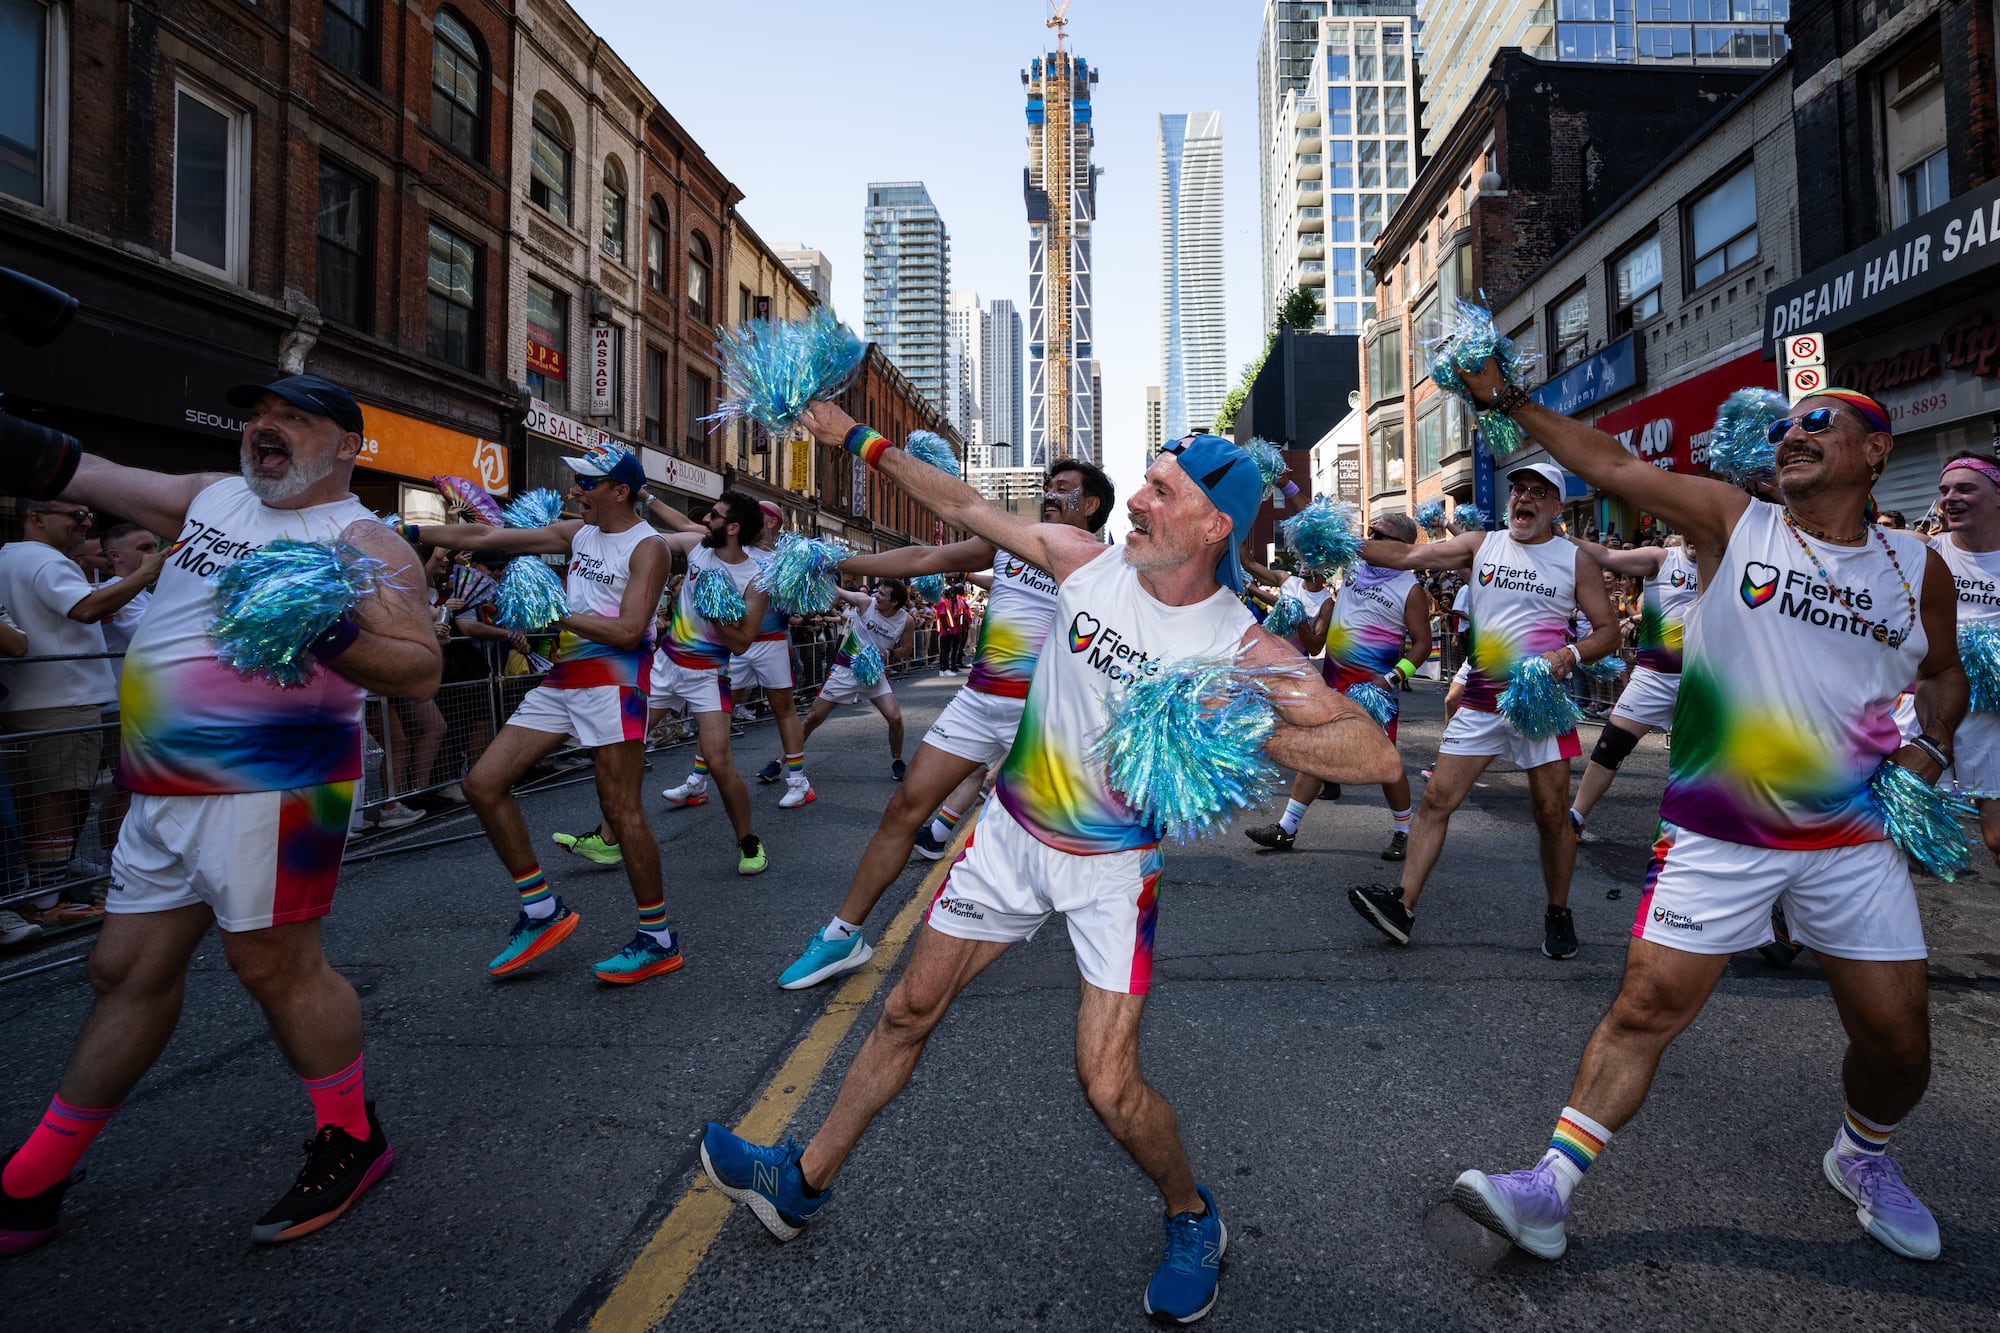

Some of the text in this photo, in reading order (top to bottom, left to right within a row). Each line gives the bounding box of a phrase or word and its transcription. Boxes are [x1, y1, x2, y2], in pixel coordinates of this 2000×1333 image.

[1772, 270, 1854, 339] DREAM
[1862, 234, 1932, 299] HAIR
[596, 330, 609, 396] MASSAGE
[593, 400, 609, 408] 594
[1558, 387, 1596, 414] Academy
[1889, 393, 1948, 421] 01-8893
[526, 409, 583, 445] OR SALE
[1640, 418, 1674, 457] 40
[679, 463, 706, 485] BLOOM
[1339, 472, 1359, 480] LEASE
[1481, 462, 1489, 504] NAKA
[1497, 565, 1537, 580] Fierté
[1494, 576, 1557, 598] Montréal
[1785, 569, 1873, 610] Fierté
[1779, 591, 1905, 650] Montréal
[948, 905, 985, 920] Montréal
[1664, 917, 1703, 931] Montréal
[1666, 910, 1693, 924] Fierté
[752, 1160, 779, 1197] N
